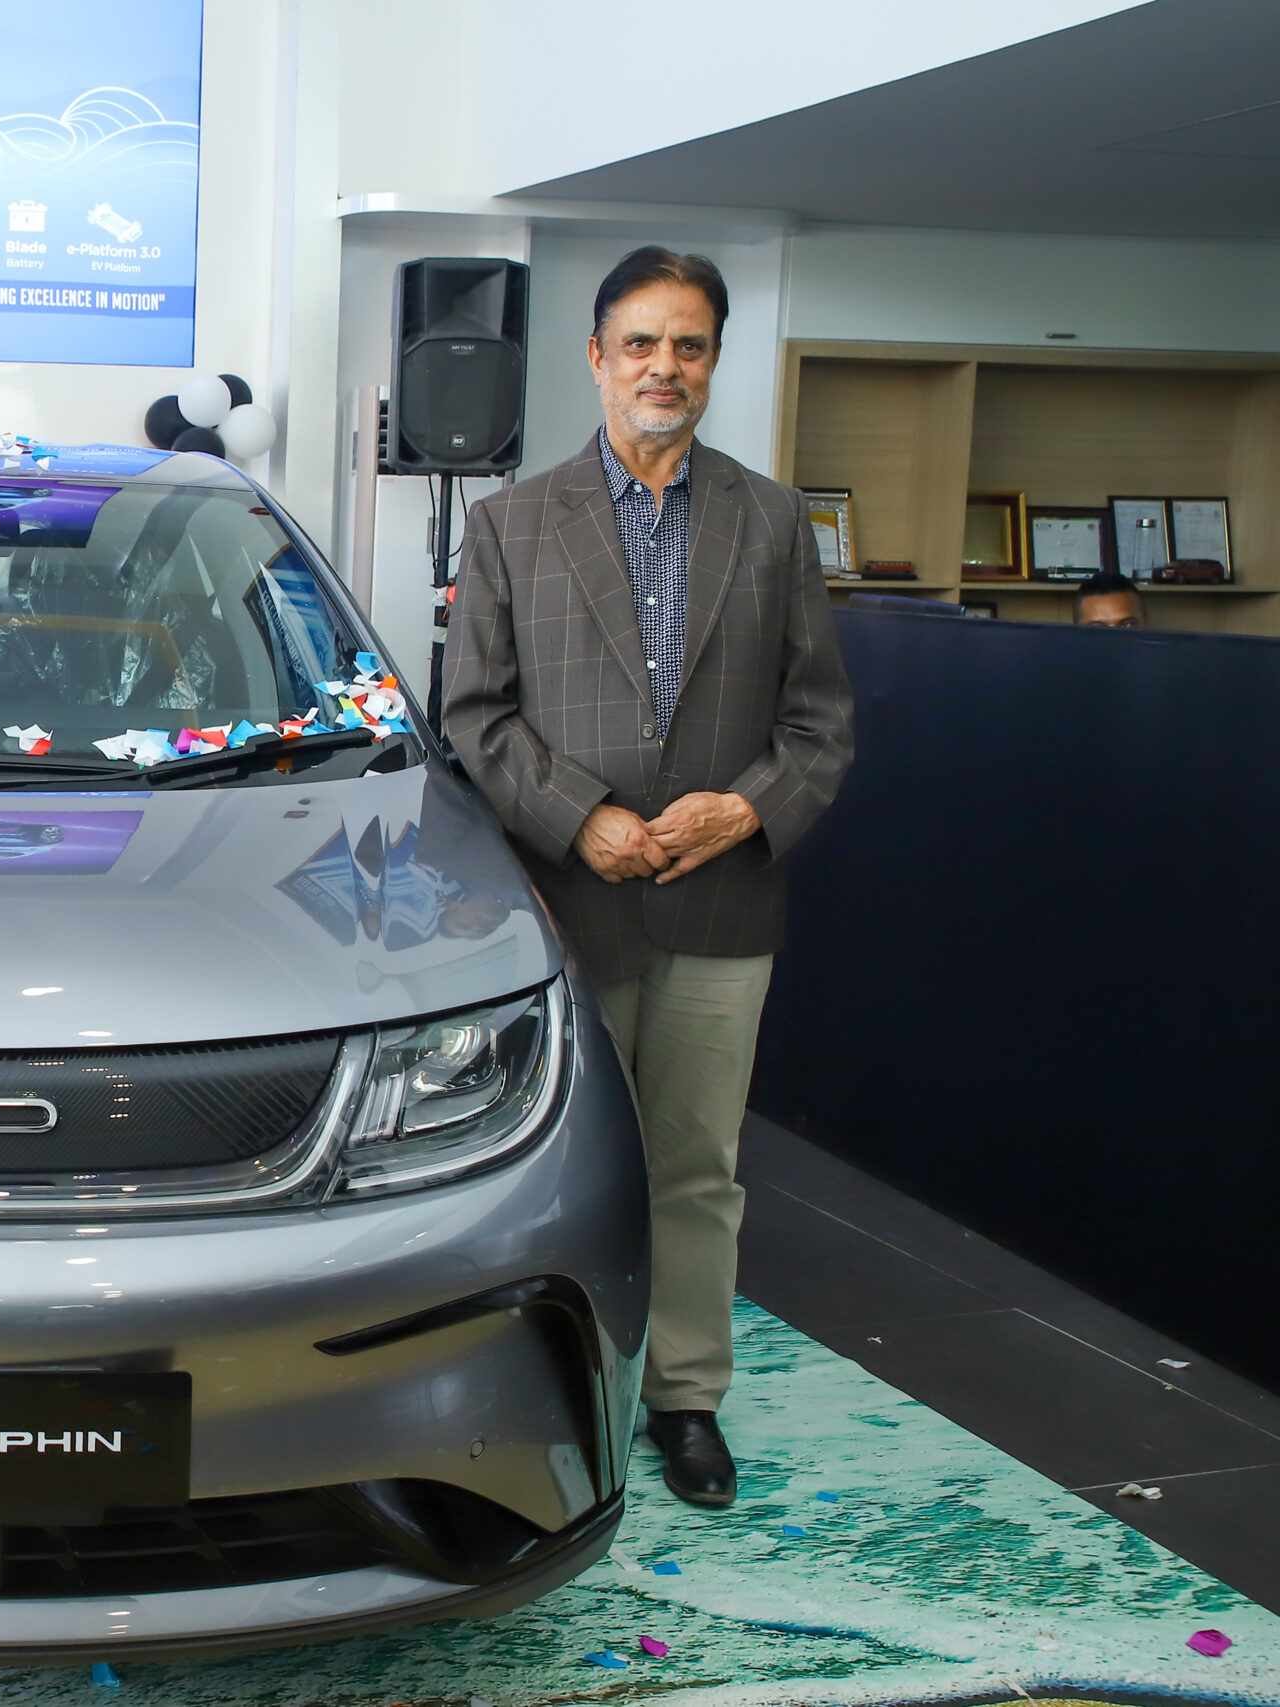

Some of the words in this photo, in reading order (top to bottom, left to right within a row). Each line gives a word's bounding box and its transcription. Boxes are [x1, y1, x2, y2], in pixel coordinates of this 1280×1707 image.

[5, 240, 47, 254] Blade
[66, 243, 137, 259] e-Platform
[140, 246, 161, 259] 3.0
[6, 258, 44, 270] Battery
[91, 261, 103, 271] EV
[104, 262, 141, 273] Platform
[21, 287, 92, 308] EXCELLENCE
[95, 291, 108, 309] IN
[111, 292, 165, 311] MOTION"
